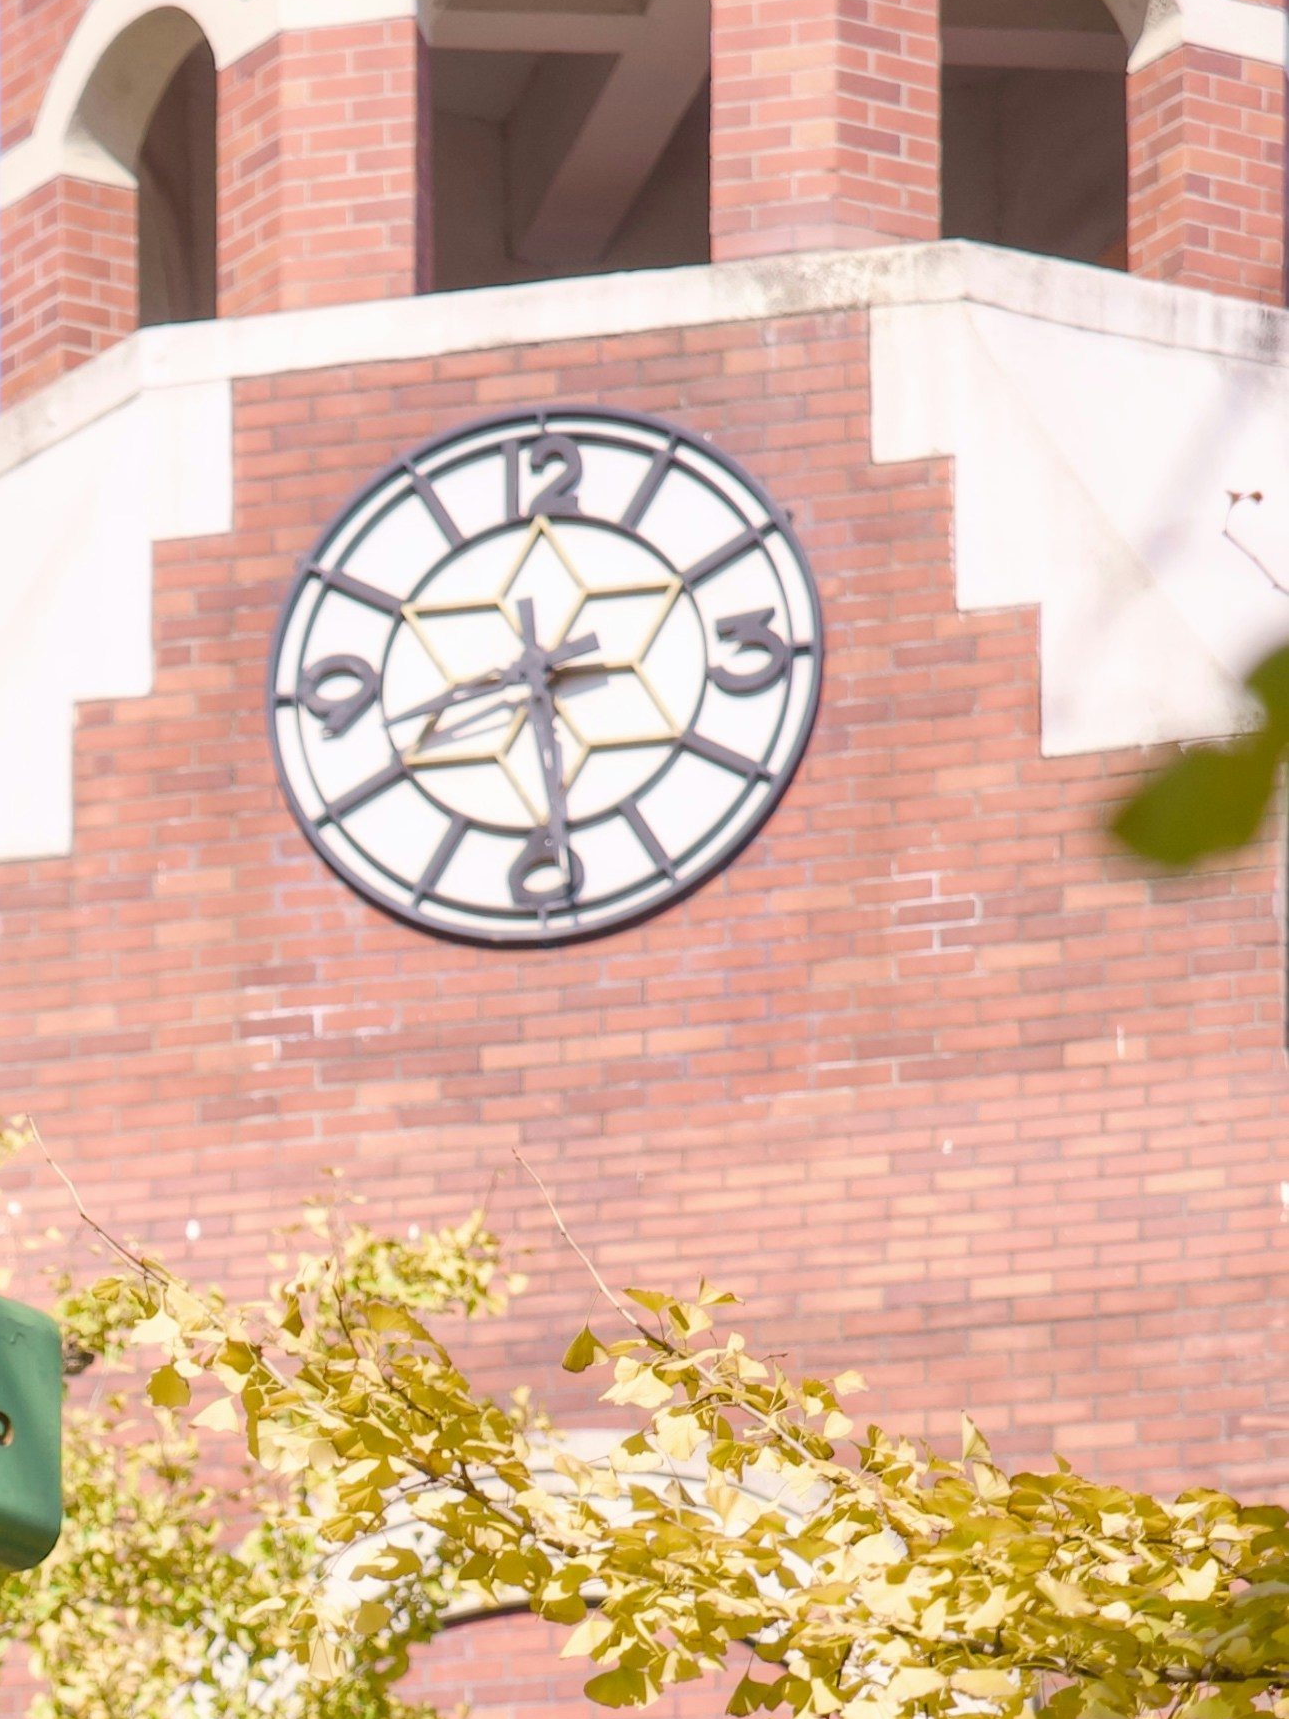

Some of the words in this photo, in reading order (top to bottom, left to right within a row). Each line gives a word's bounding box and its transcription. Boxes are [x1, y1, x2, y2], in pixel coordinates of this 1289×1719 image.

[501, 435, 583, 522] 12
[706, 606, 788, 697] 3
[296, 653, 382, 738] 9
